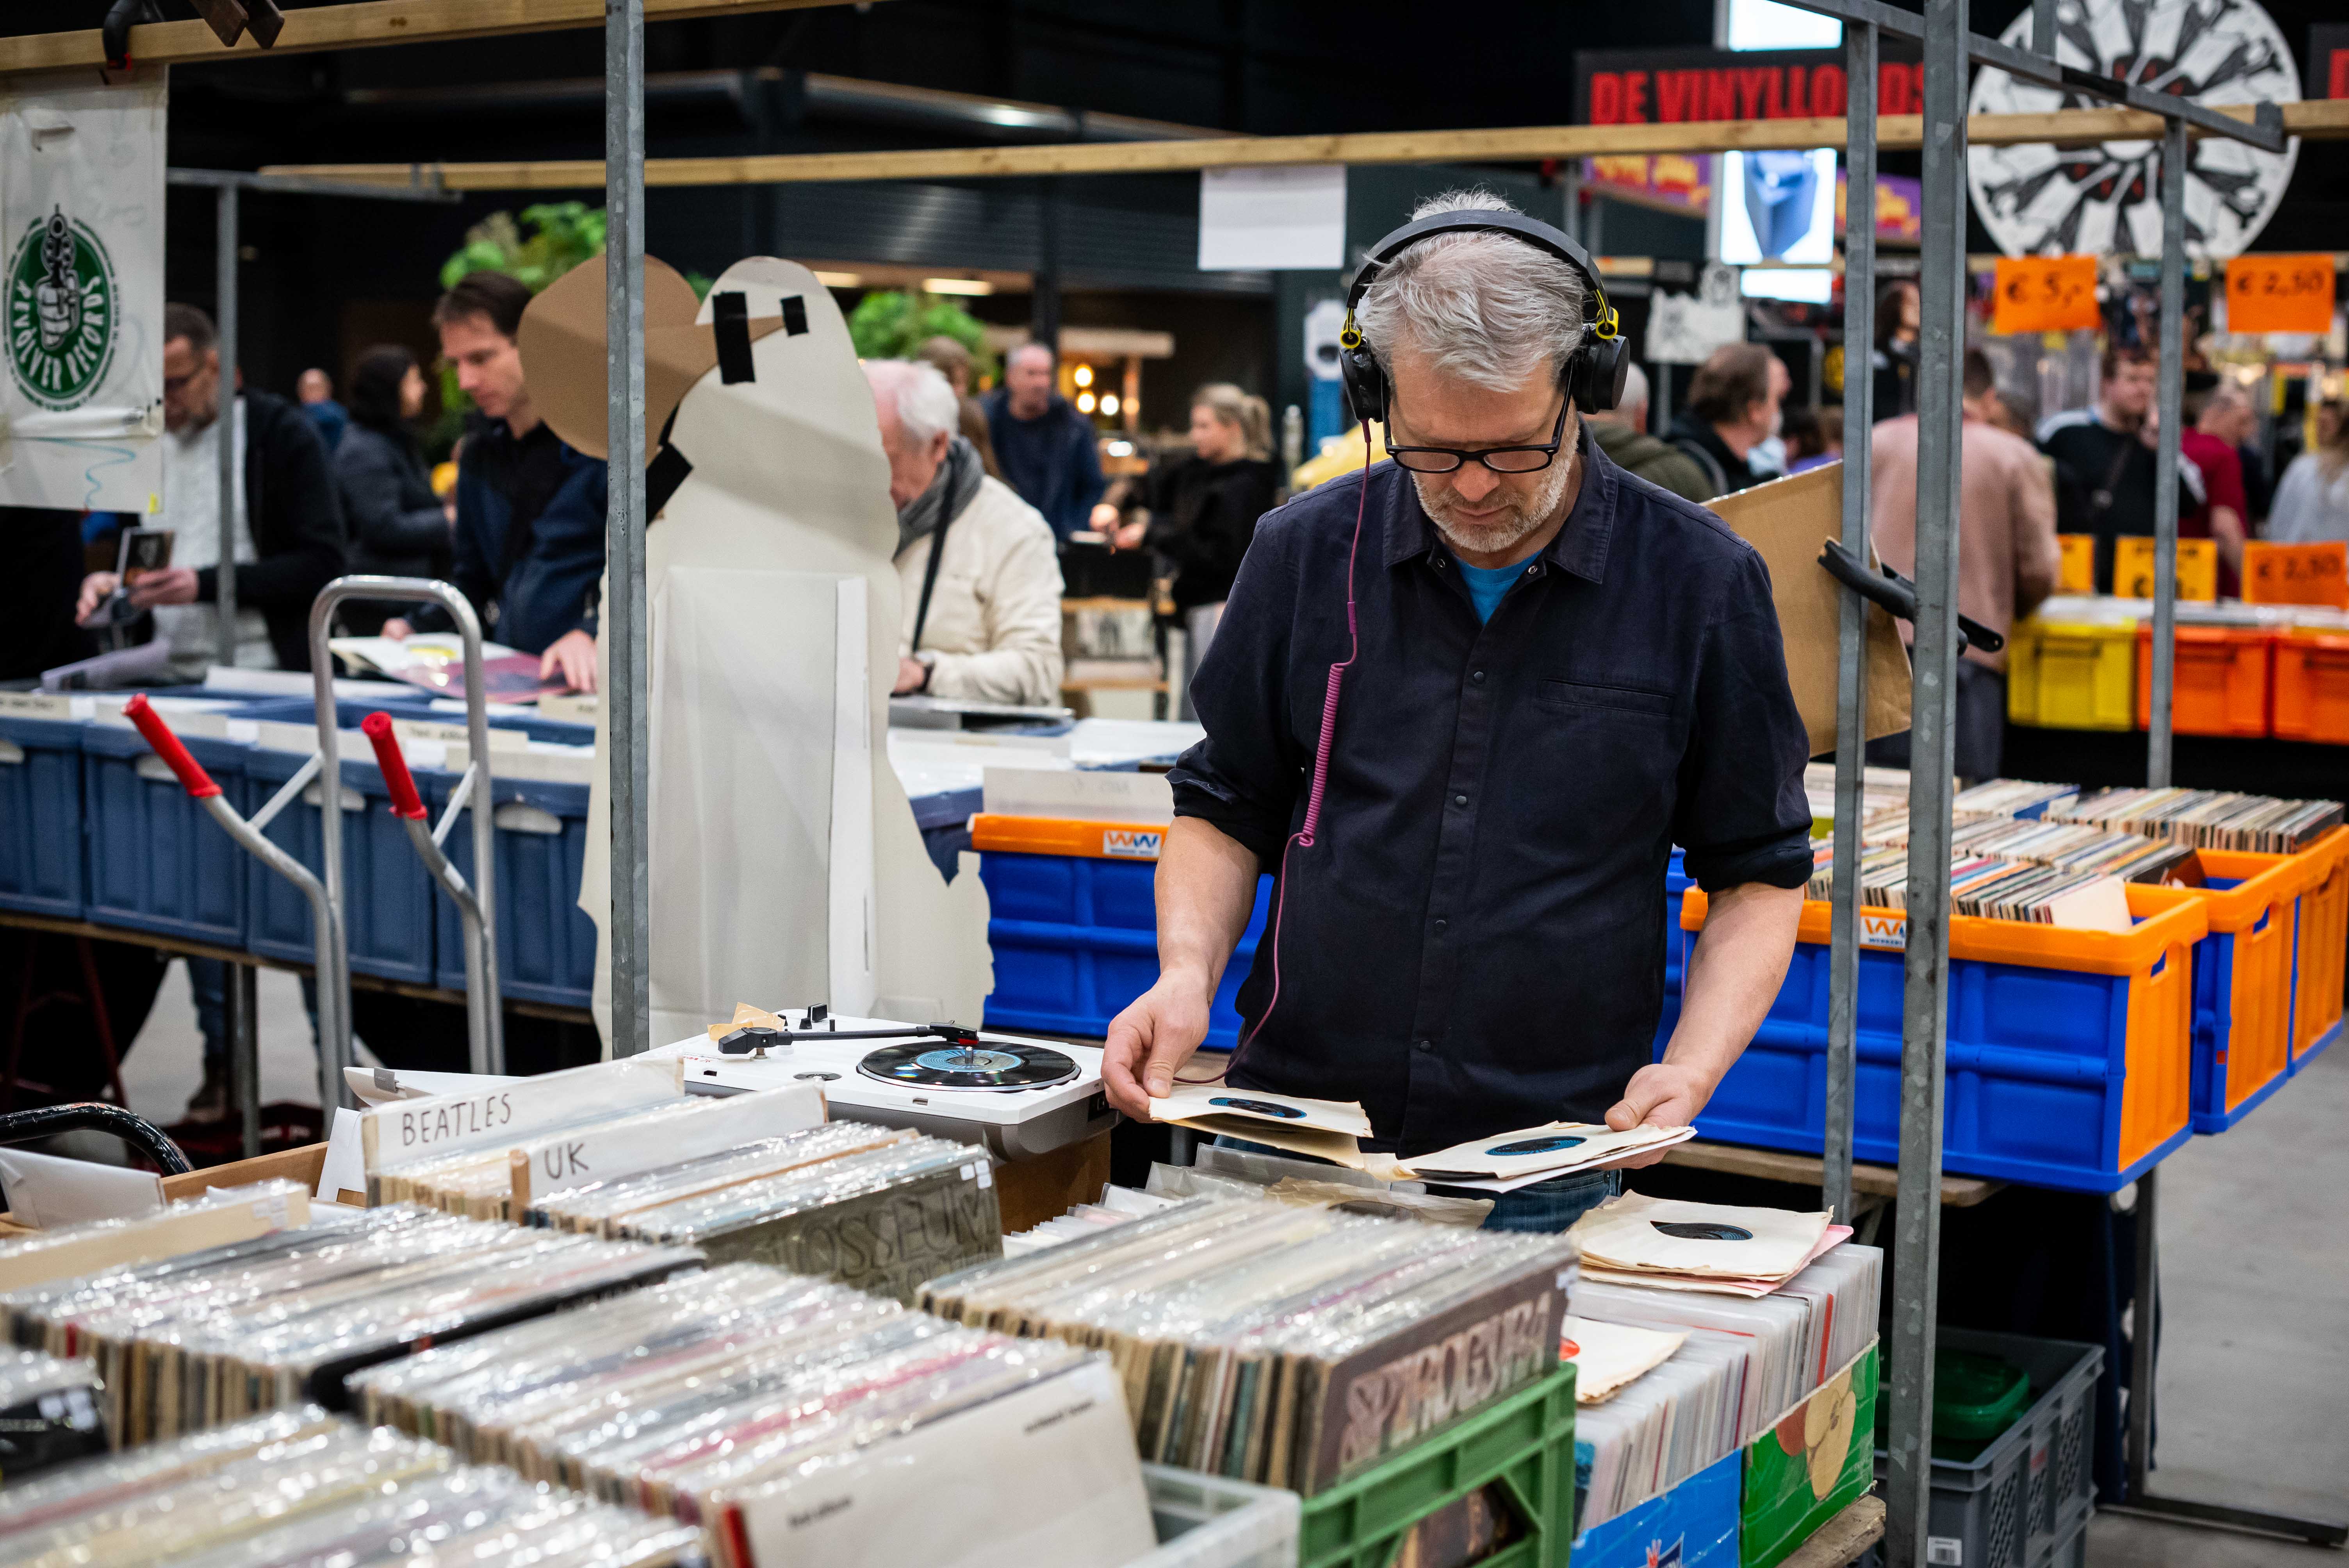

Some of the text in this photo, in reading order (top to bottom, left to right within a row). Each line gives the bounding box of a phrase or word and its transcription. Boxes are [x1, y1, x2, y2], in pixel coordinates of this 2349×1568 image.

[1591, 72, 1648, 124] DE
[65, 276, 105, 385] RECORDS
[402, 1093, 512, 1147] BEATLES
[545, 1142, 590, 1180] UK
